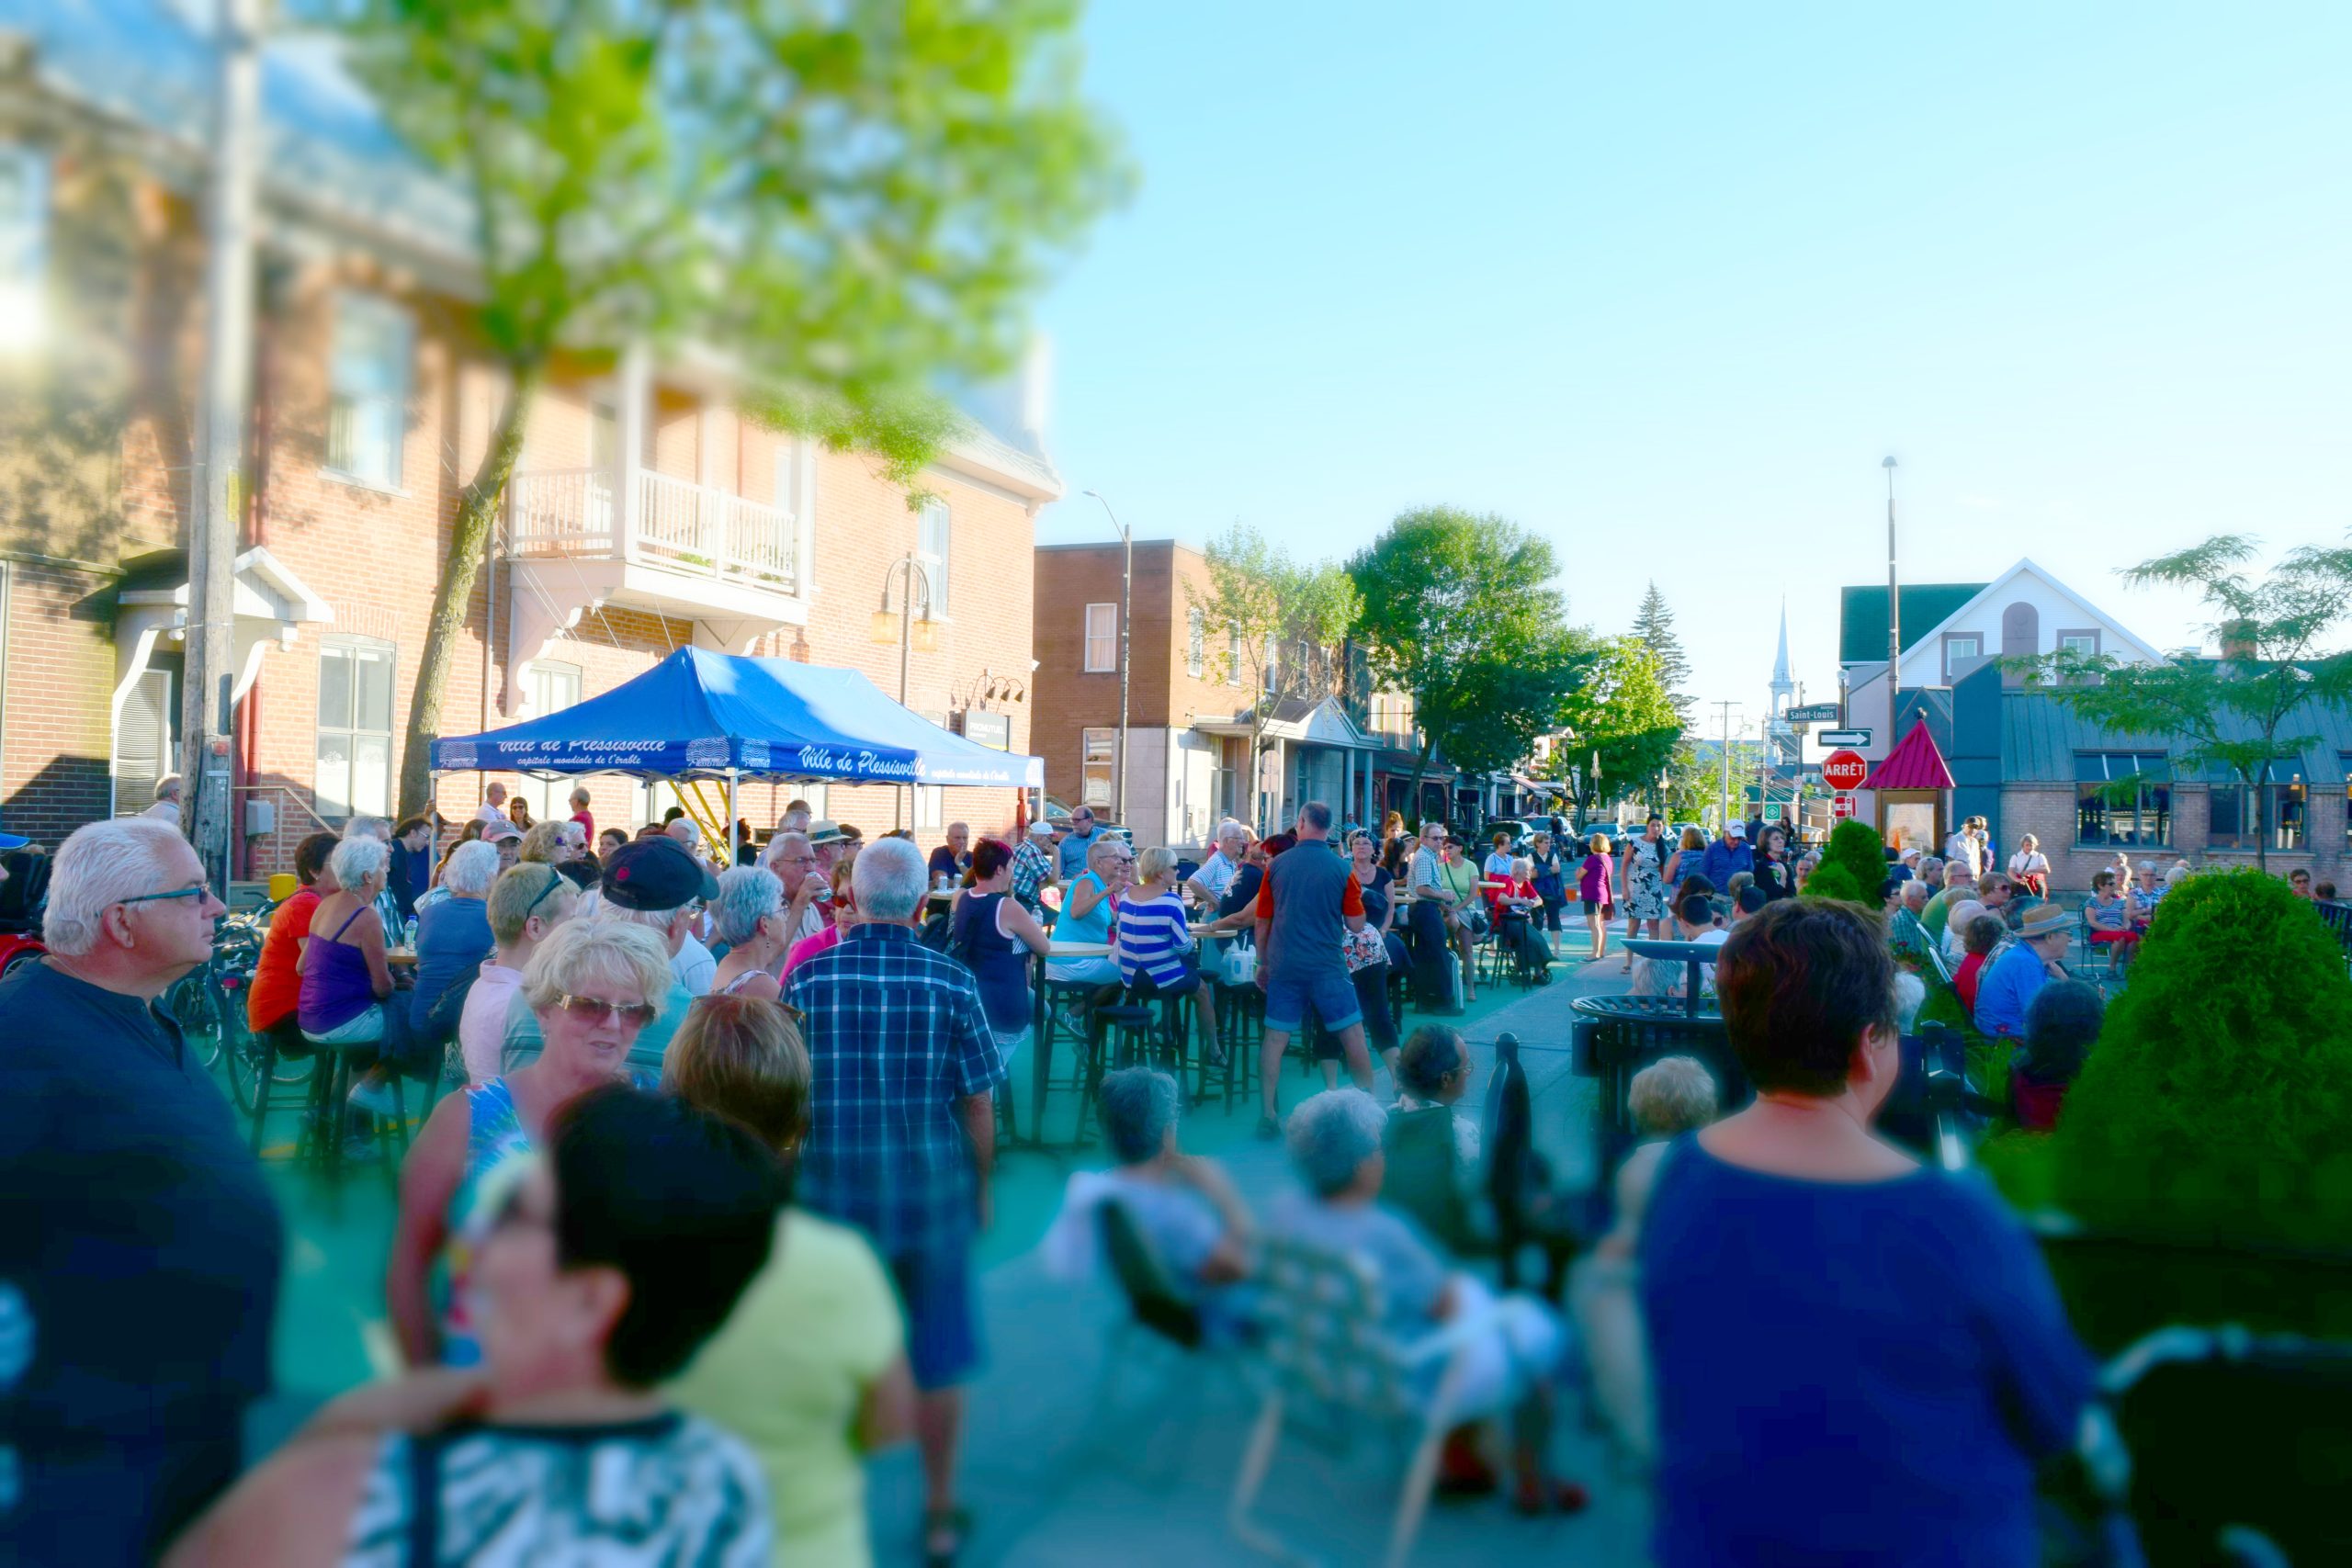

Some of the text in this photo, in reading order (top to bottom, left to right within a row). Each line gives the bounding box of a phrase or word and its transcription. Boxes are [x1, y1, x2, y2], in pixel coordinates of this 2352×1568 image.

[1790, 710, 1834, 720] Saint-Louis
[517, 755, 551, 766] capitale
[553, 755, 593, 765] mondiale
[594, 755, 605, 764] de
[797, 744, 927, 777] Ville de Plessisville
[1825, 761, 1865, 776] ARRÊT
